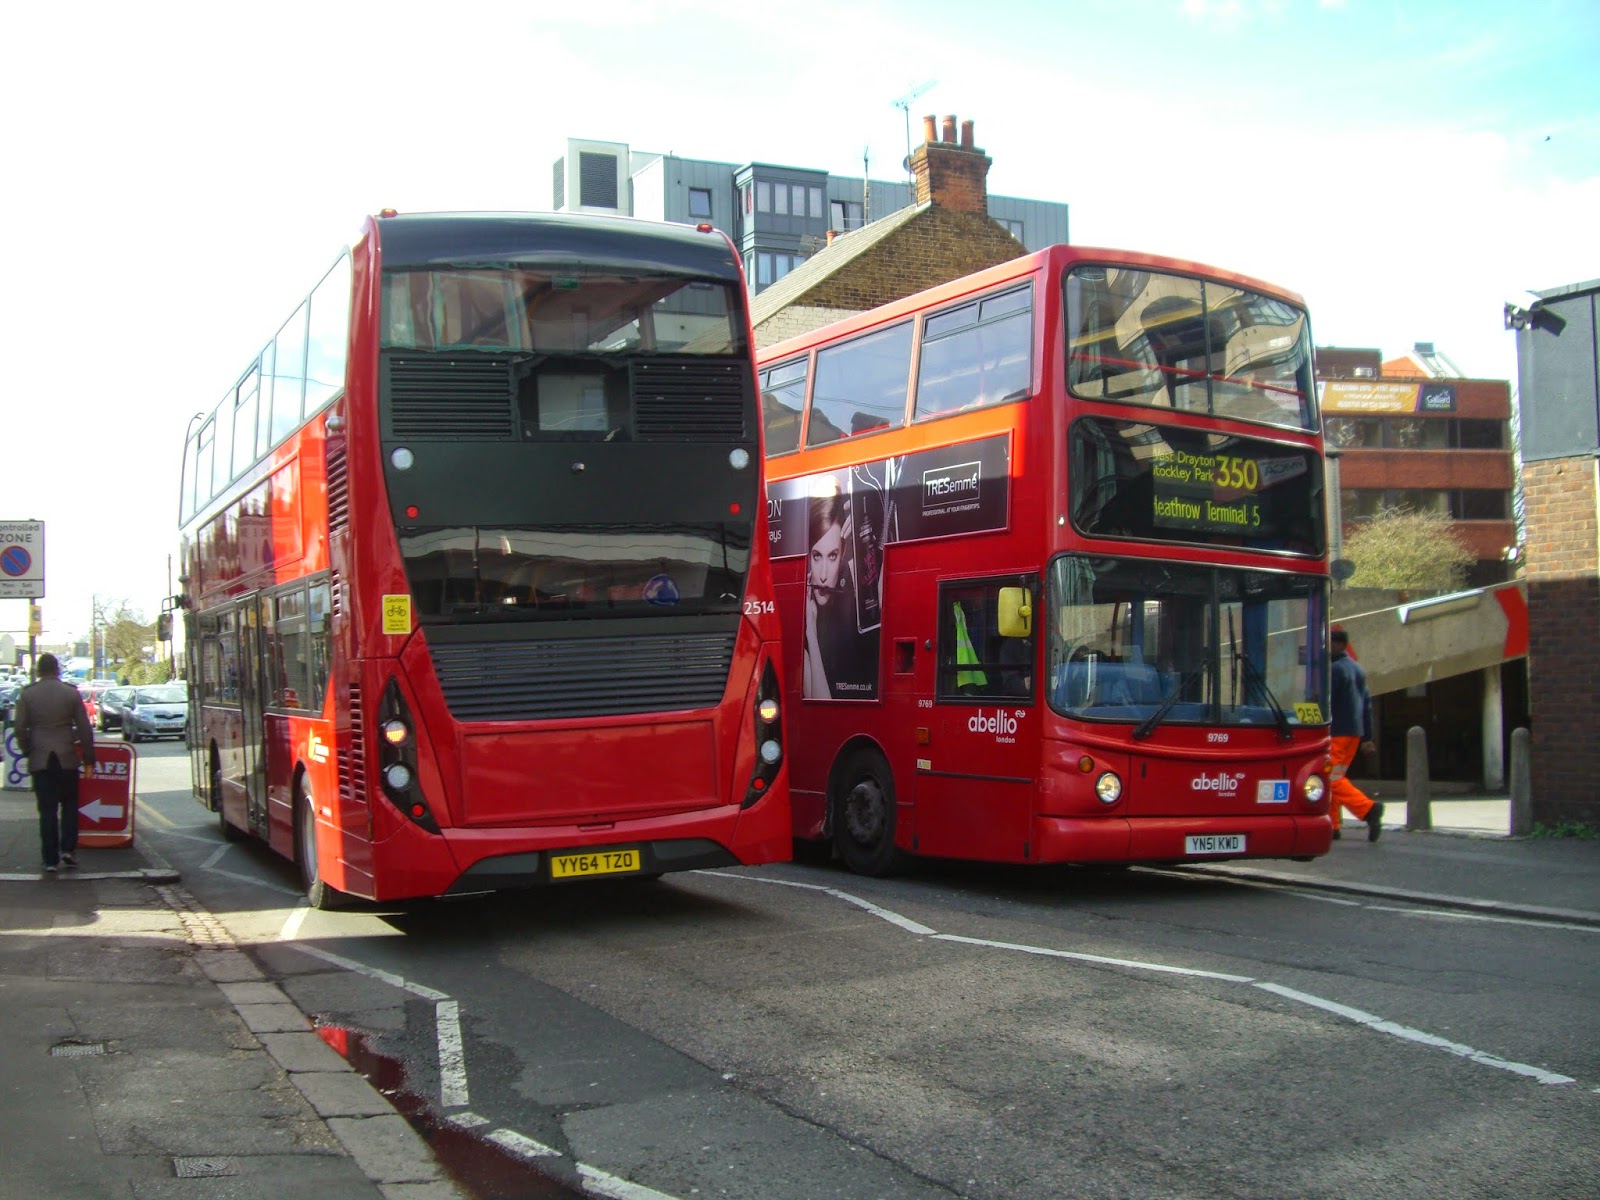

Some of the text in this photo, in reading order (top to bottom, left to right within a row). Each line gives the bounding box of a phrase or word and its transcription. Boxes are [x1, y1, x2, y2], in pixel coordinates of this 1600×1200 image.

[1178, 451, 1216, 468] Drayton
[1195, 468, 1214, 481] Park
[1216, 455, 1258, 490] 350
[926, 473, 977, 496] TRESemmé
[1206, 500, 1248, 524] Terminal
[1253, 505, 1260, 526] 5
[0, 533, 32, 543] ZONE
[743, 601, 775, 615] 2514
[918, 699, 933, 709] 9769
[968, 708, 1018, 735] abellio
[1297, 707, 1322, 724] 255
[995, 735, 1016, 744] london
[1208, 733, 1229, 743] 9769
[1192, 772, 1238, 791] abellio
[1192, 836, 1239, 851] YN51 KWD
[559, 855, 599, 873] YY64
